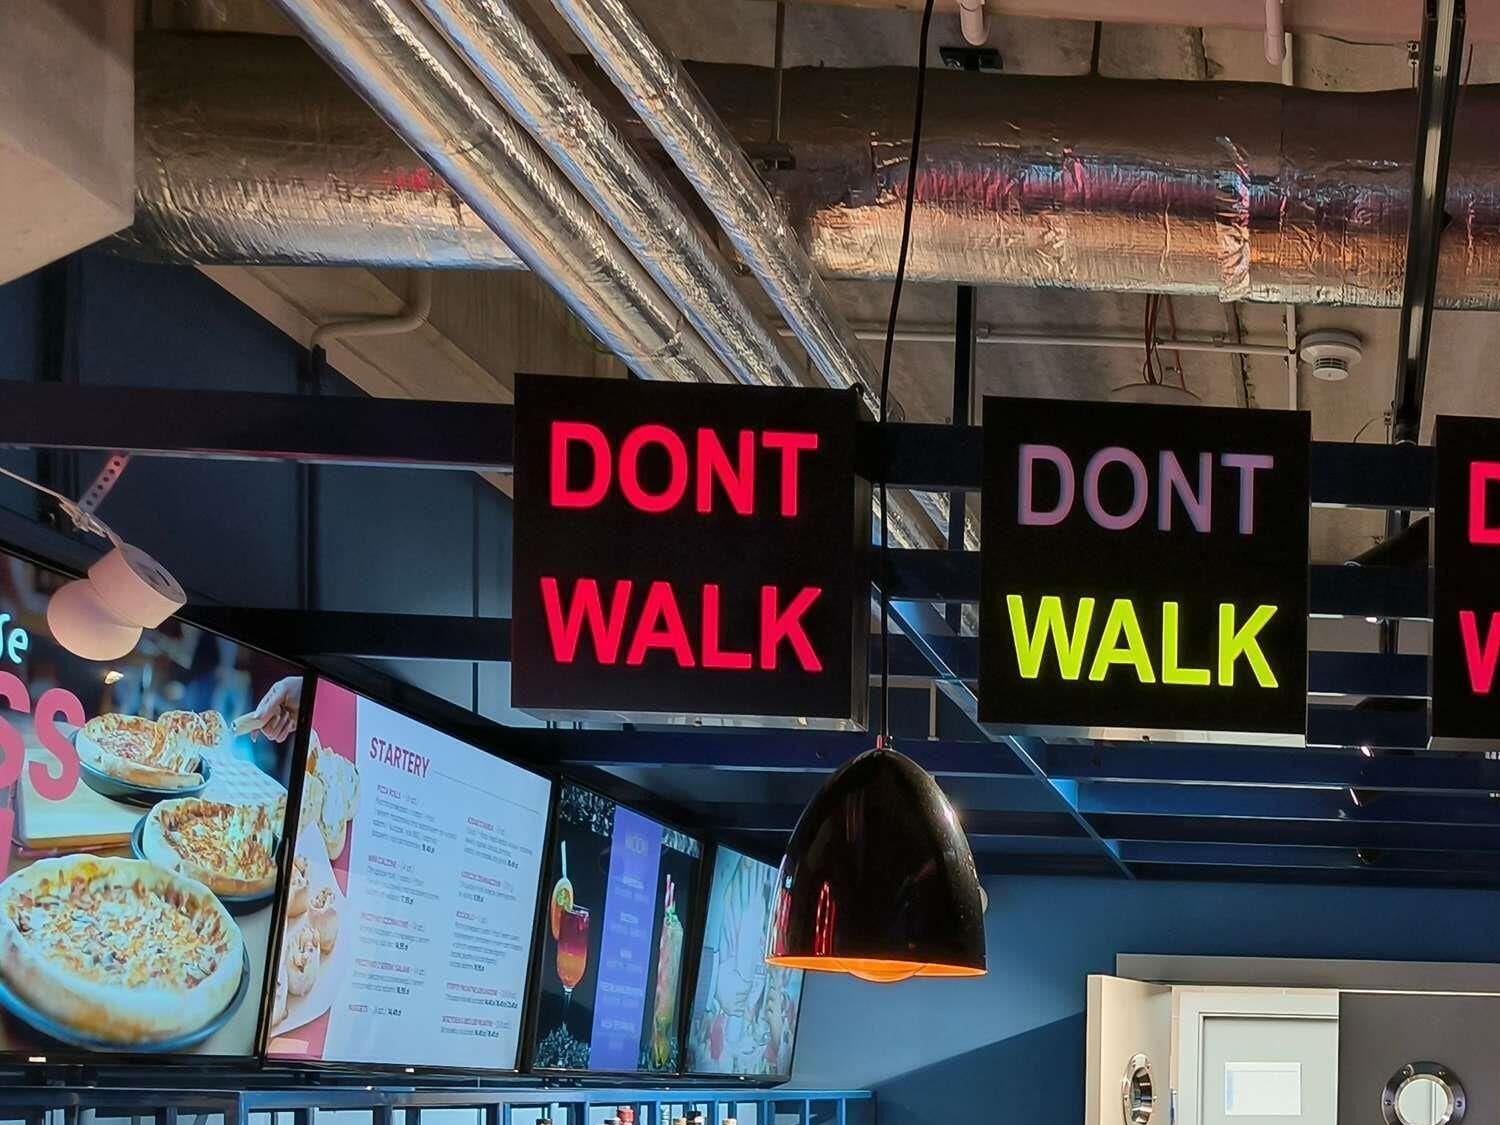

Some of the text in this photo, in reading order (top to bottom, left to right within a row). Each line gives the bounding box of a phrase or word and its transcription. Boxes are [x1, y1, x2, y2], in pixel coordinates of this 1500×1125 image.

[551, 422, 818, 516] DONT
[1019, 445, 1273, 534] DONT
[541, 578, 822, 671] WALK
[1007, 595, 1278, 688] WALK
[370, 737, 430, 778] STARTERY
